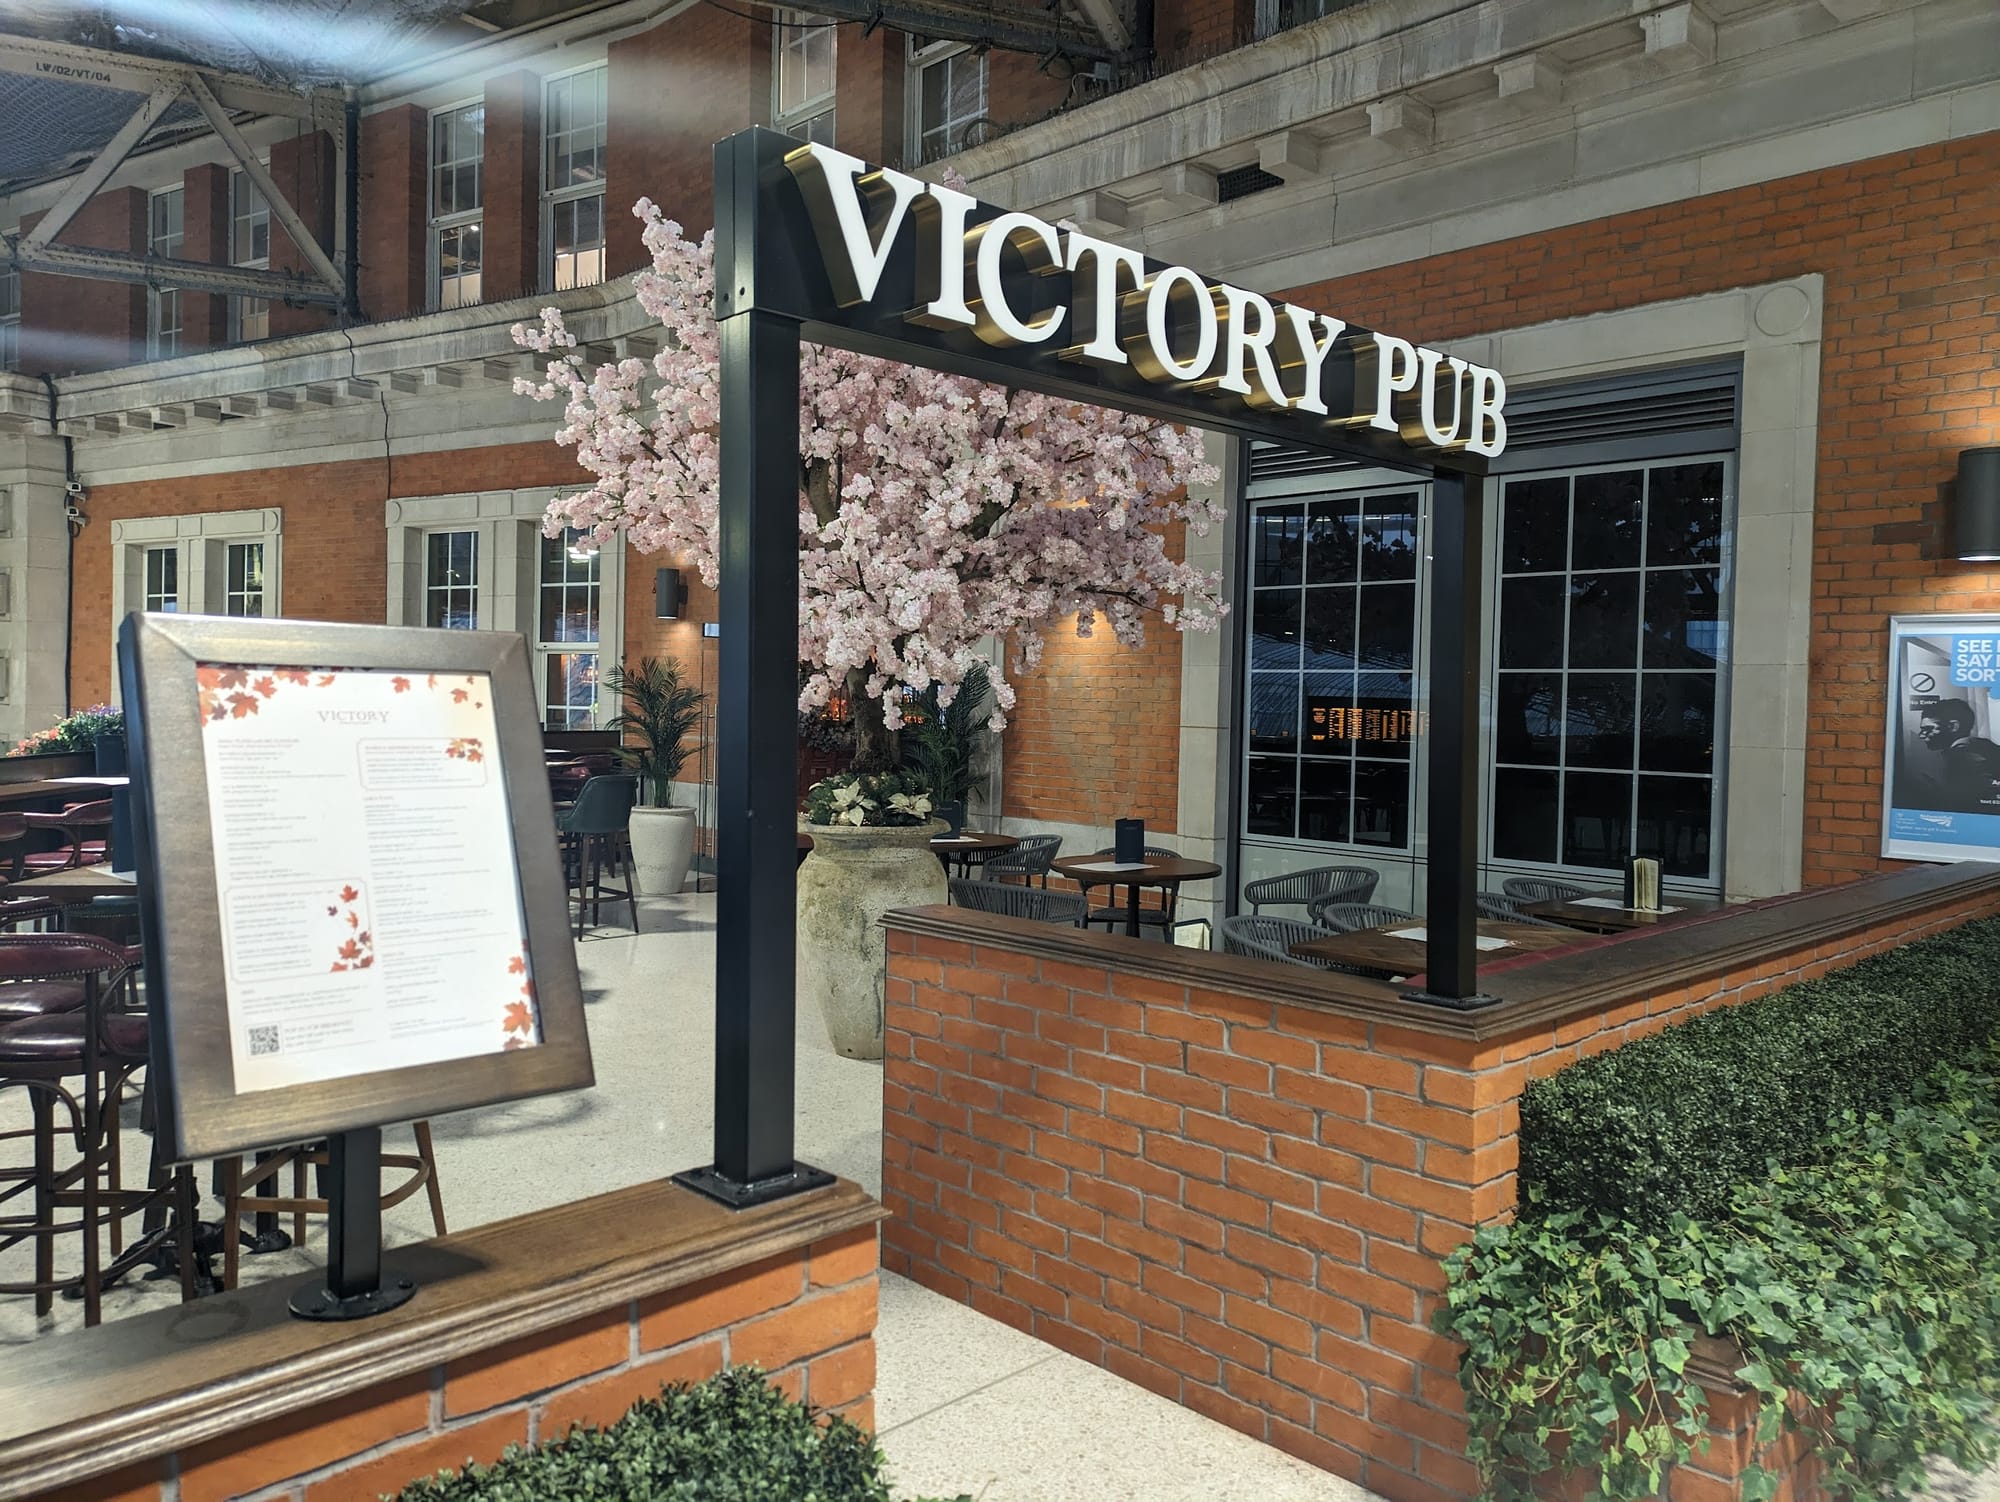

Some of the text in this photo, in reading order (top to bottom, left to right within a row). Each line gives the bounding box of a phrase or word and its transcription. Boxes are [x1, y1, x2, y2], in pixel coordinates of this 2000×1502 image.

[35, 62, 111, 82] LW/02/VT/04
[809, 142, 1508, 458] VICTORY PUB
[1958, 640, 1993, 653] SEE
[1957, 654, 1993, 667] SAY
[316, 709, 389, 723] VICTORY
